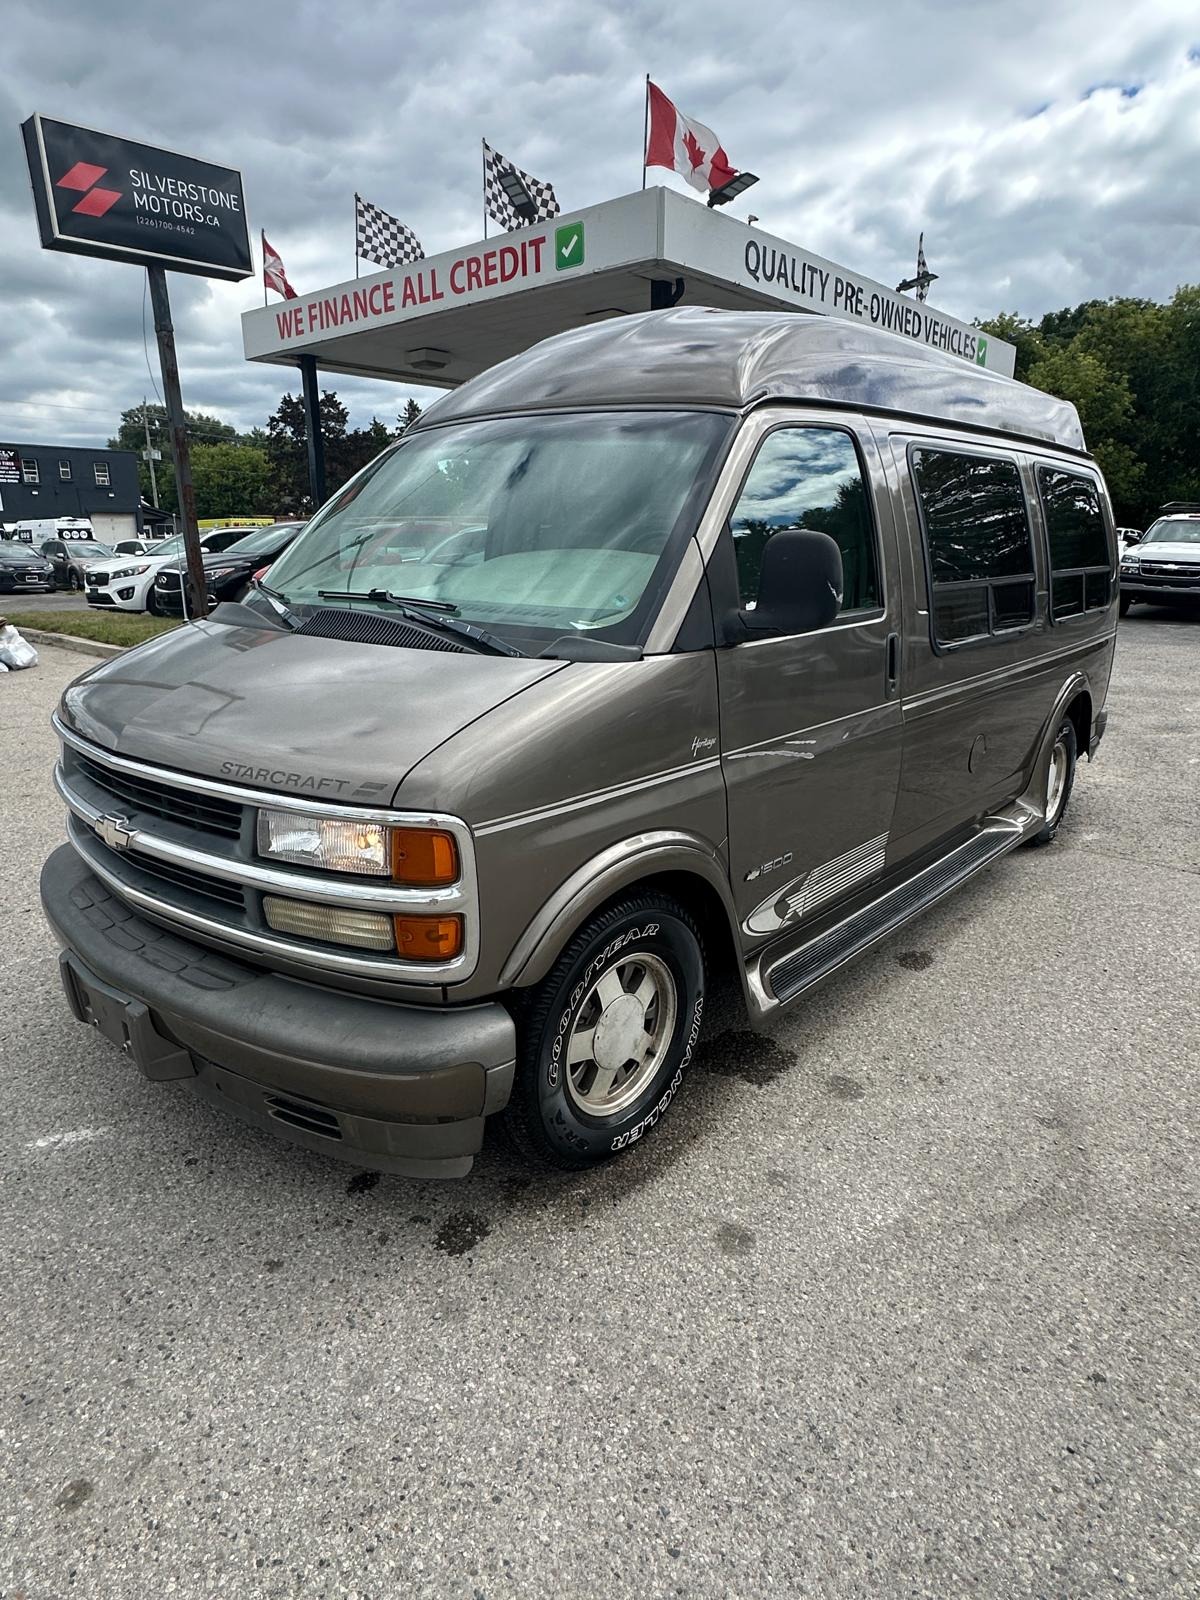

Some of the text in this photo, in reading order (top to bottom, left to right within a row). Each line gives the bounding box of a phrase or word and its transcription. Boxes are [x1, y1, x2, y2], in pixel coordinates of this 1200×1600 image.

[129, 169, 240, 212] SILVERSTONE
[133, 191, 220, 227] MOTORS.CA
[136, 215, 195, 235] (226)700-4542
[275, 235, 547, 340] WE FINANCE ALL CREDIT
[744, 239, 977, 360] QUALITY PRE-OWNED VEHICLES
[691, 735, 717, 757] Heritage
[220, 761, 350, 793] STARCRAFT
[760, 852, 793, 876] 1500
[548, 923, 660, 1088] GOODYEAR
[610, 997, 704, 1151] WRANGLER
